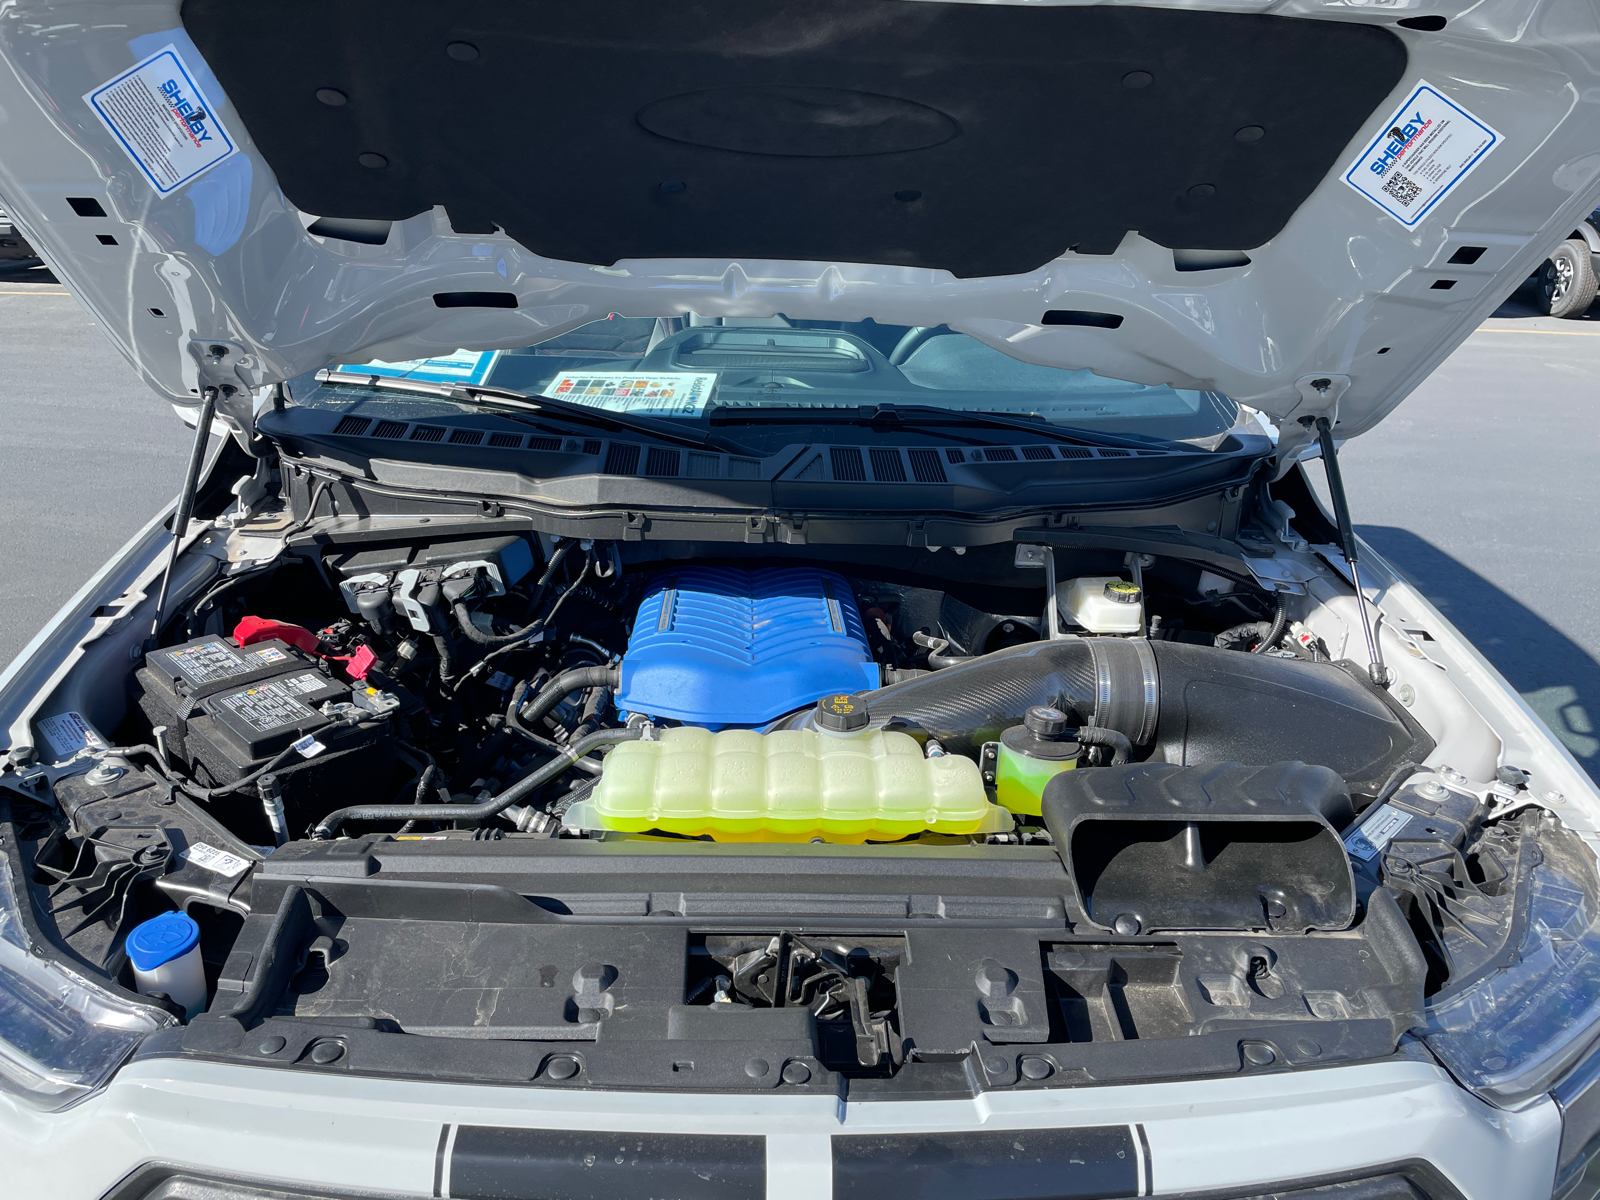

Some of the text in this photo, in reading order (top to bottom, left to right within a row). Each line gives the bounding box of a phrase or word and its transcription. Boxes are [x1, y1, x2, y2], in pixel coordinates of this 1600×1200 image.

[162, 79, 212, 142] SHELBY
[171, 107, 202, 148] performance
[1370, 111, 1426, 175] SHELBY
[1396, 119, 1433, 160] performance
